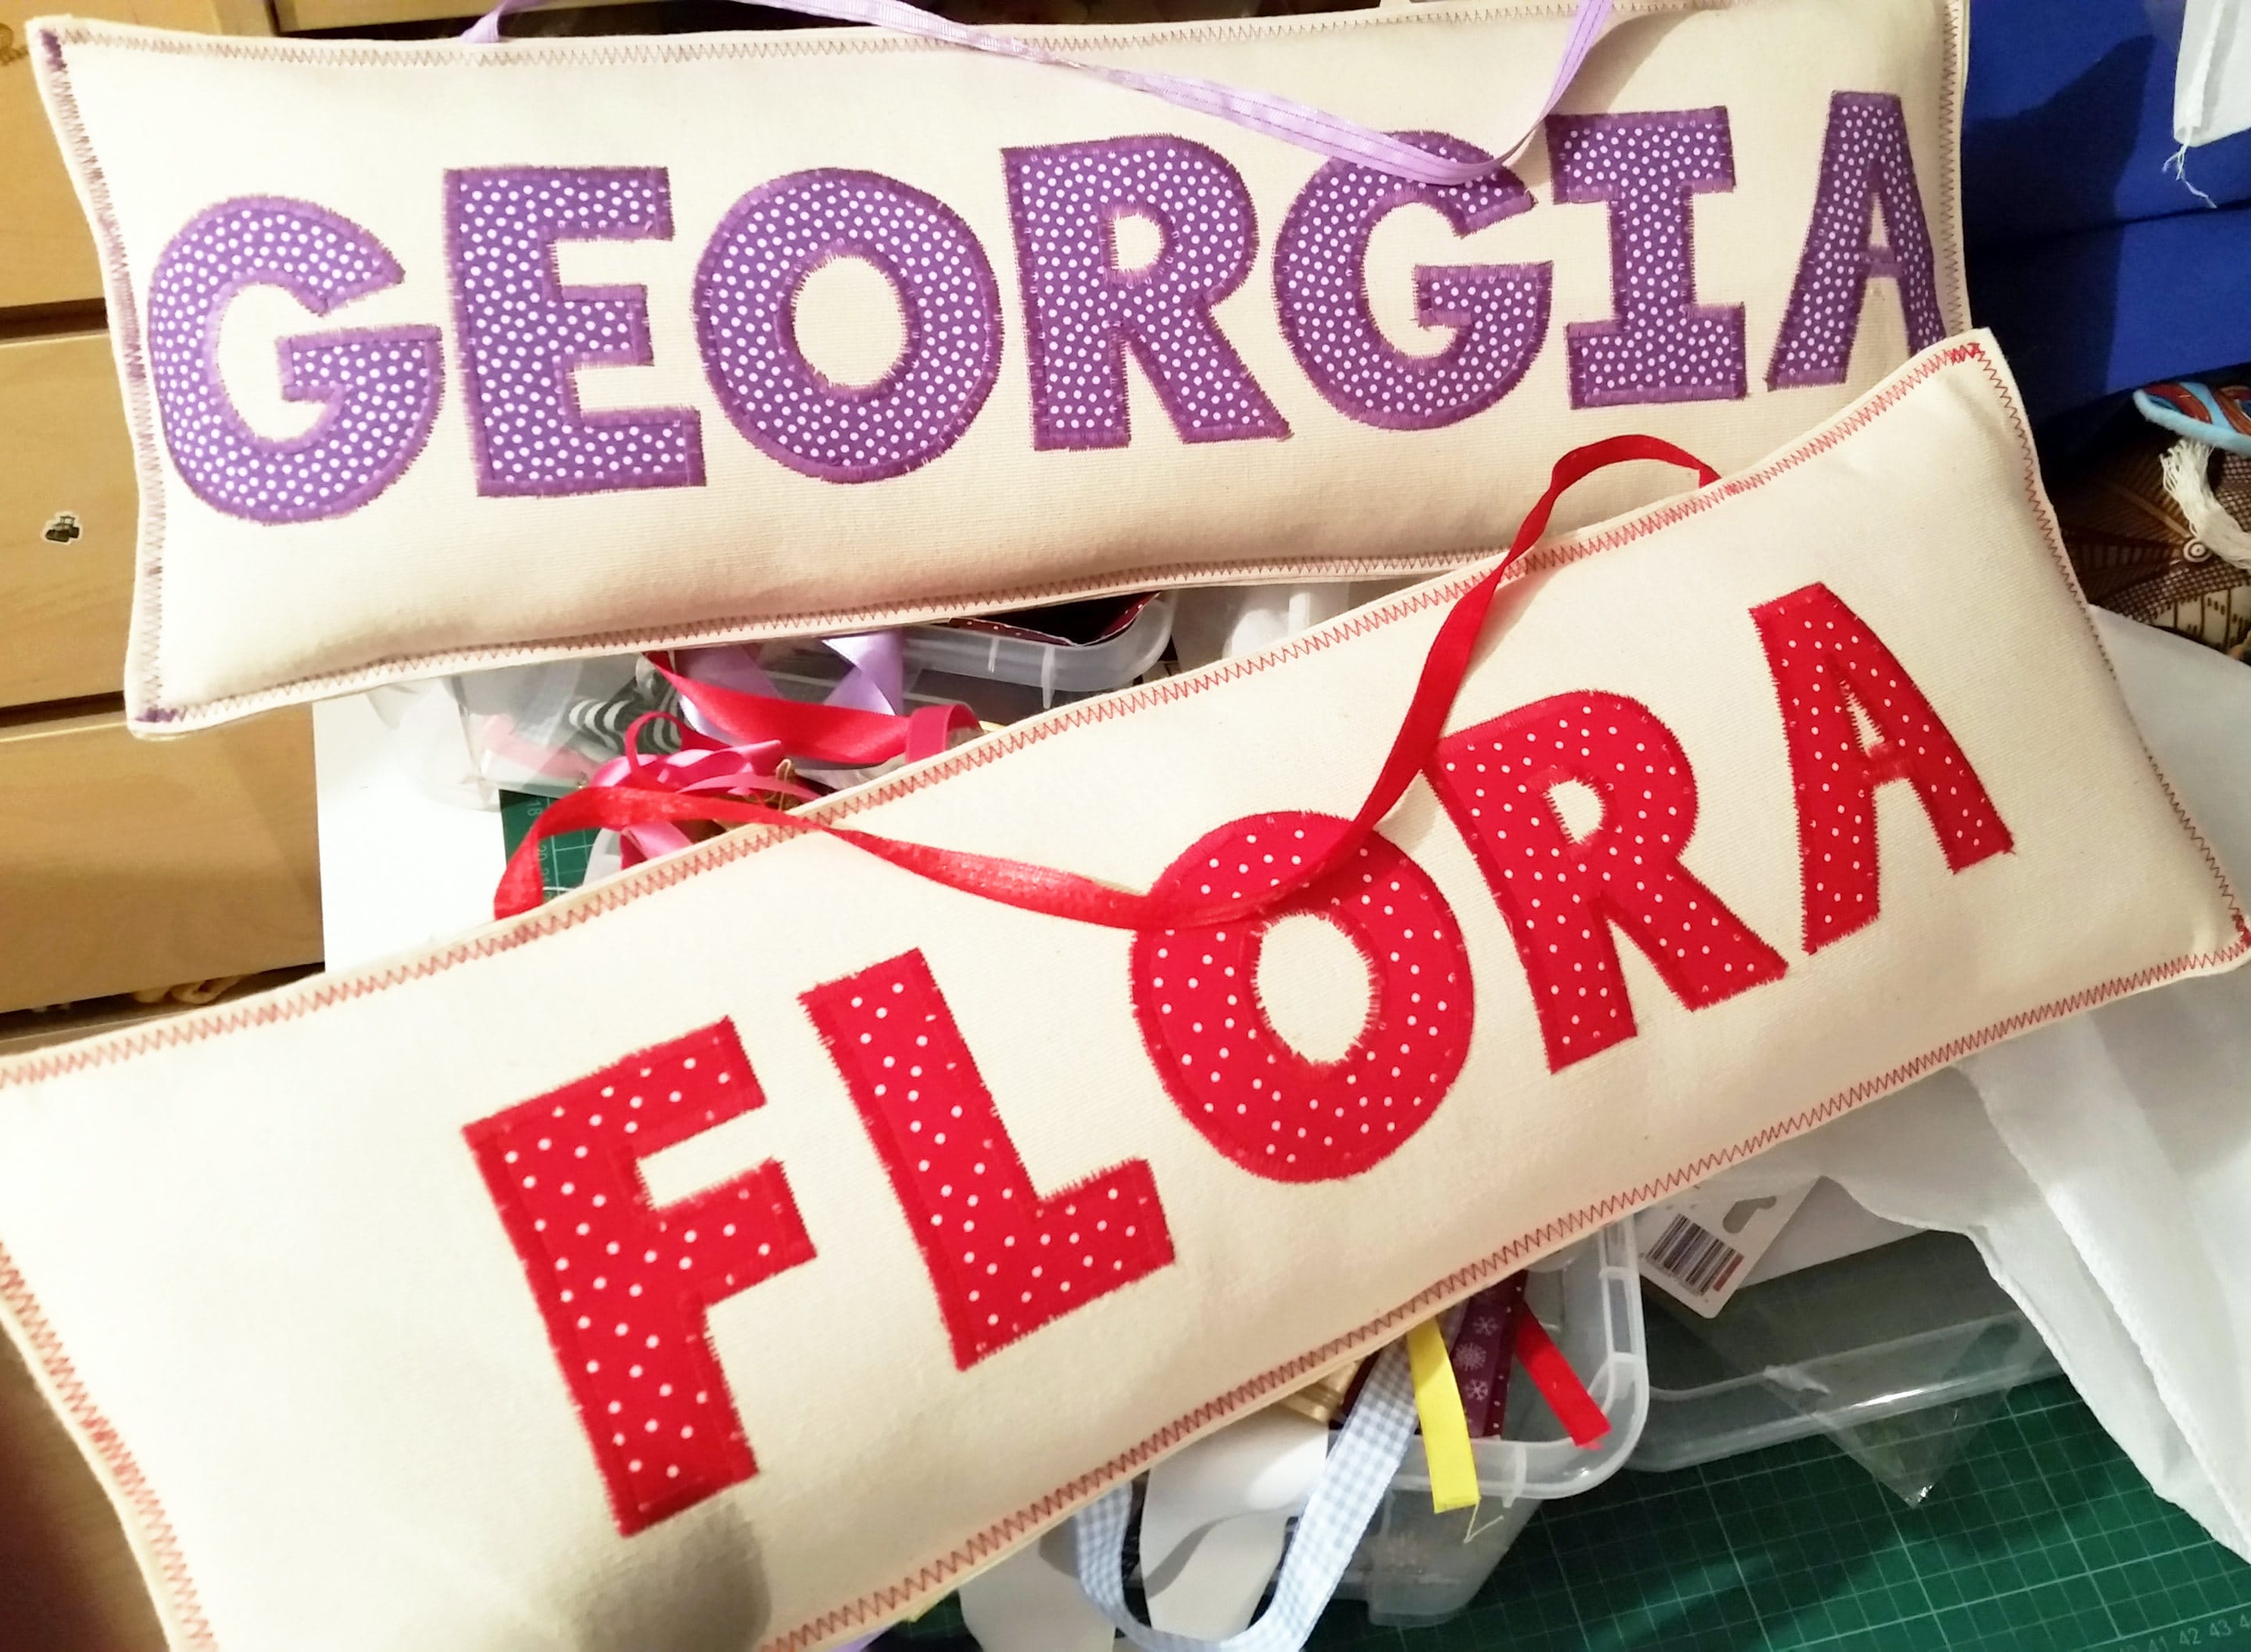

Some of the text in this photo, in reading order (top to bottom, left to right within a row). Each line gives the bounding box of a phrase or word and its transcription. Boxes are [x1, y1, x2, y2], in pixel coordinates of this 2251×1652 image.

[147, 91, 1946, 525] GEORGIA
[527, 799, 542, 817] 18
[462, 581, 2015, 1538] FLORA
[2149, 1636, 2170, 1652] 41
[2179, 1628, 2202, 1645] 42
[2210, 1619, 2231, 1637] 43
[2240, 1614, 2251, 1630] 4
